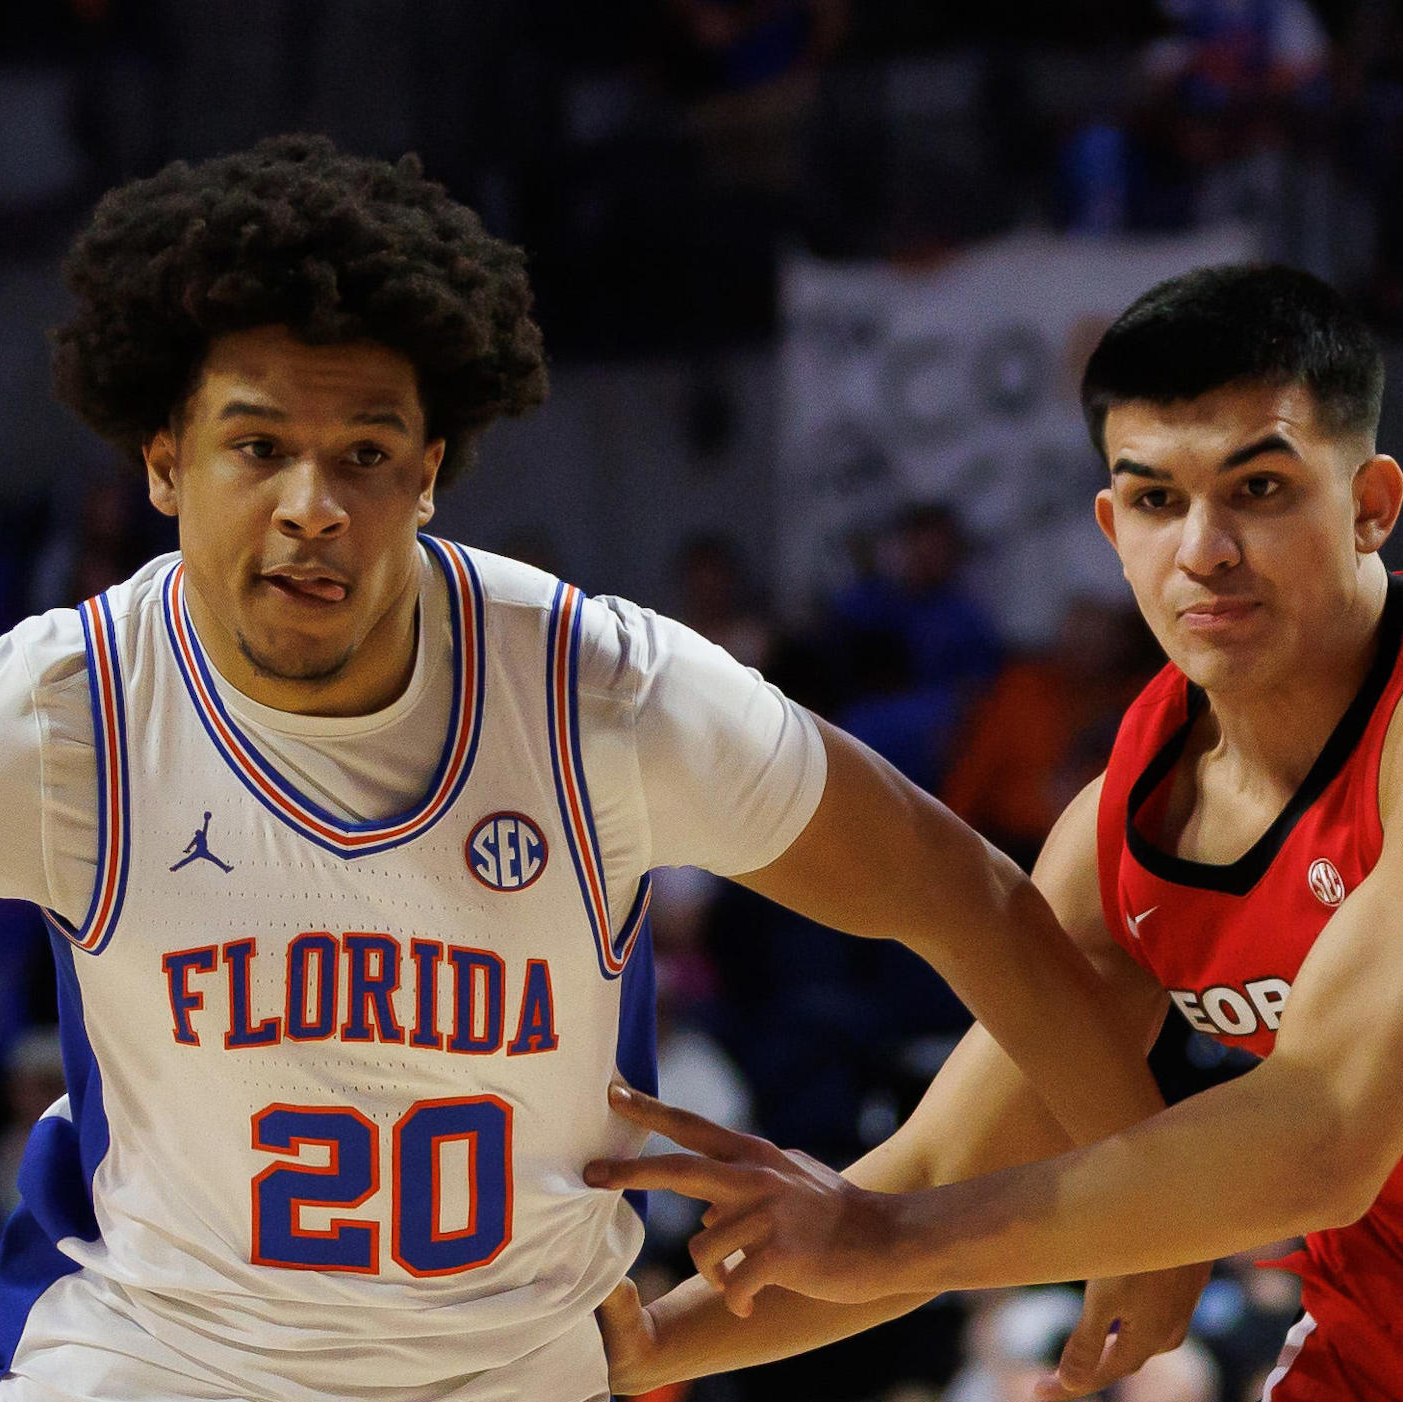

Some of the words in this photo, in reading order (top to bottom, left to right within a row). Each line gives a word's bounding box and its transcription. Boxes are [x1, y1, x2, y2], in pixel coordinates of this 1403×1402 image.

[472, 819, 541, 888] SEC
[162, 931, 559, 1057] FLORIDA
[1168, 978, 1292, 1035] EOR
[251, 1094, 513, 1278] 20
